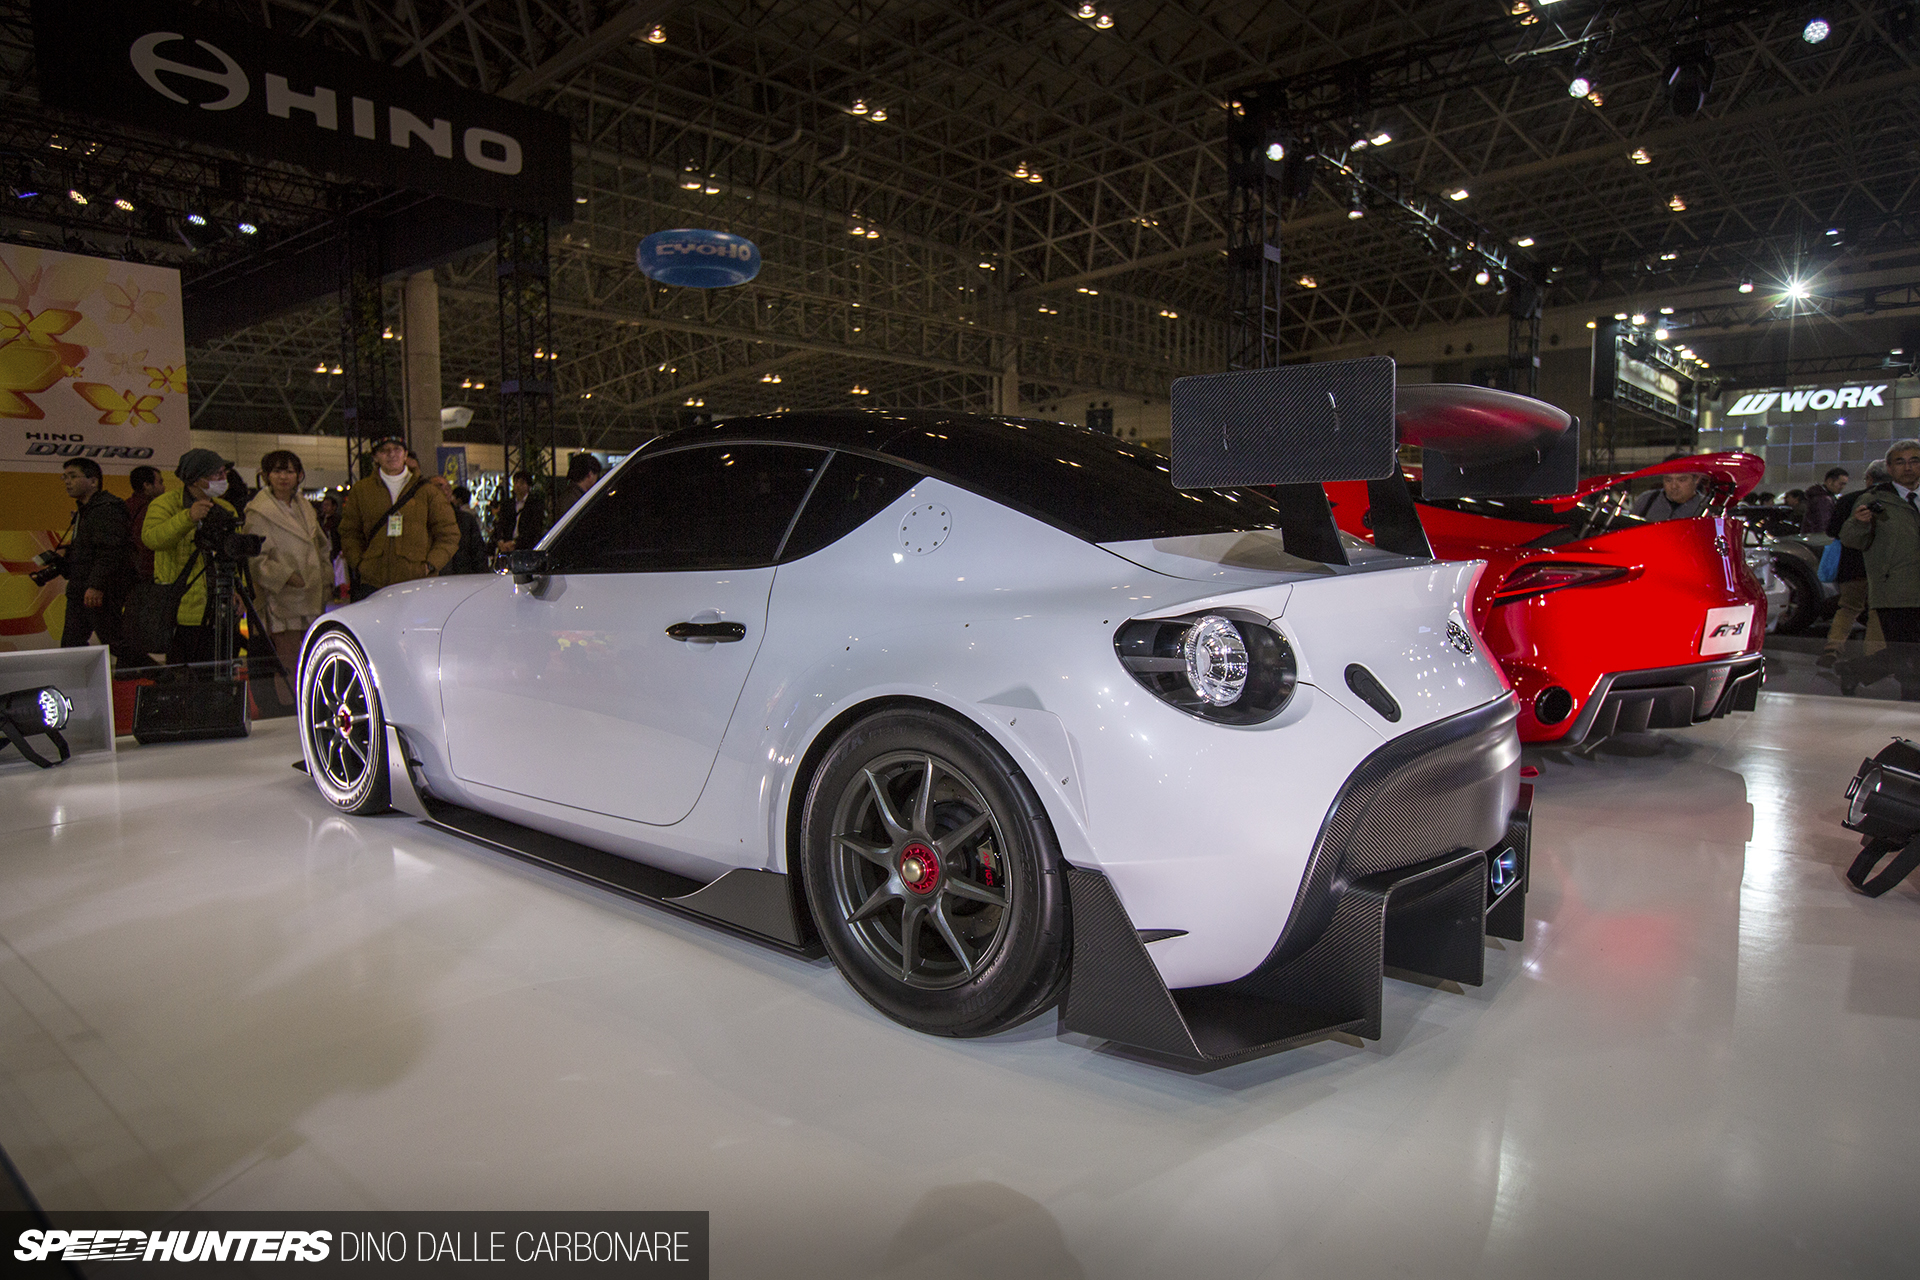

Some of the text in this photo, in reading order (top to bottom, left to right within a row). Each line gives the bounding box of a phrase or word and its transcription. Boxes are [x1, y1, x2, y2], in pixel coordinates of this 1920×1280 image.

[266, 73, 523, 176] HINO
[1780, 385, 1888, 412] WORK
[26, 432, 84, 442] HINO
[25, 443, 155, 459] DUTRO
